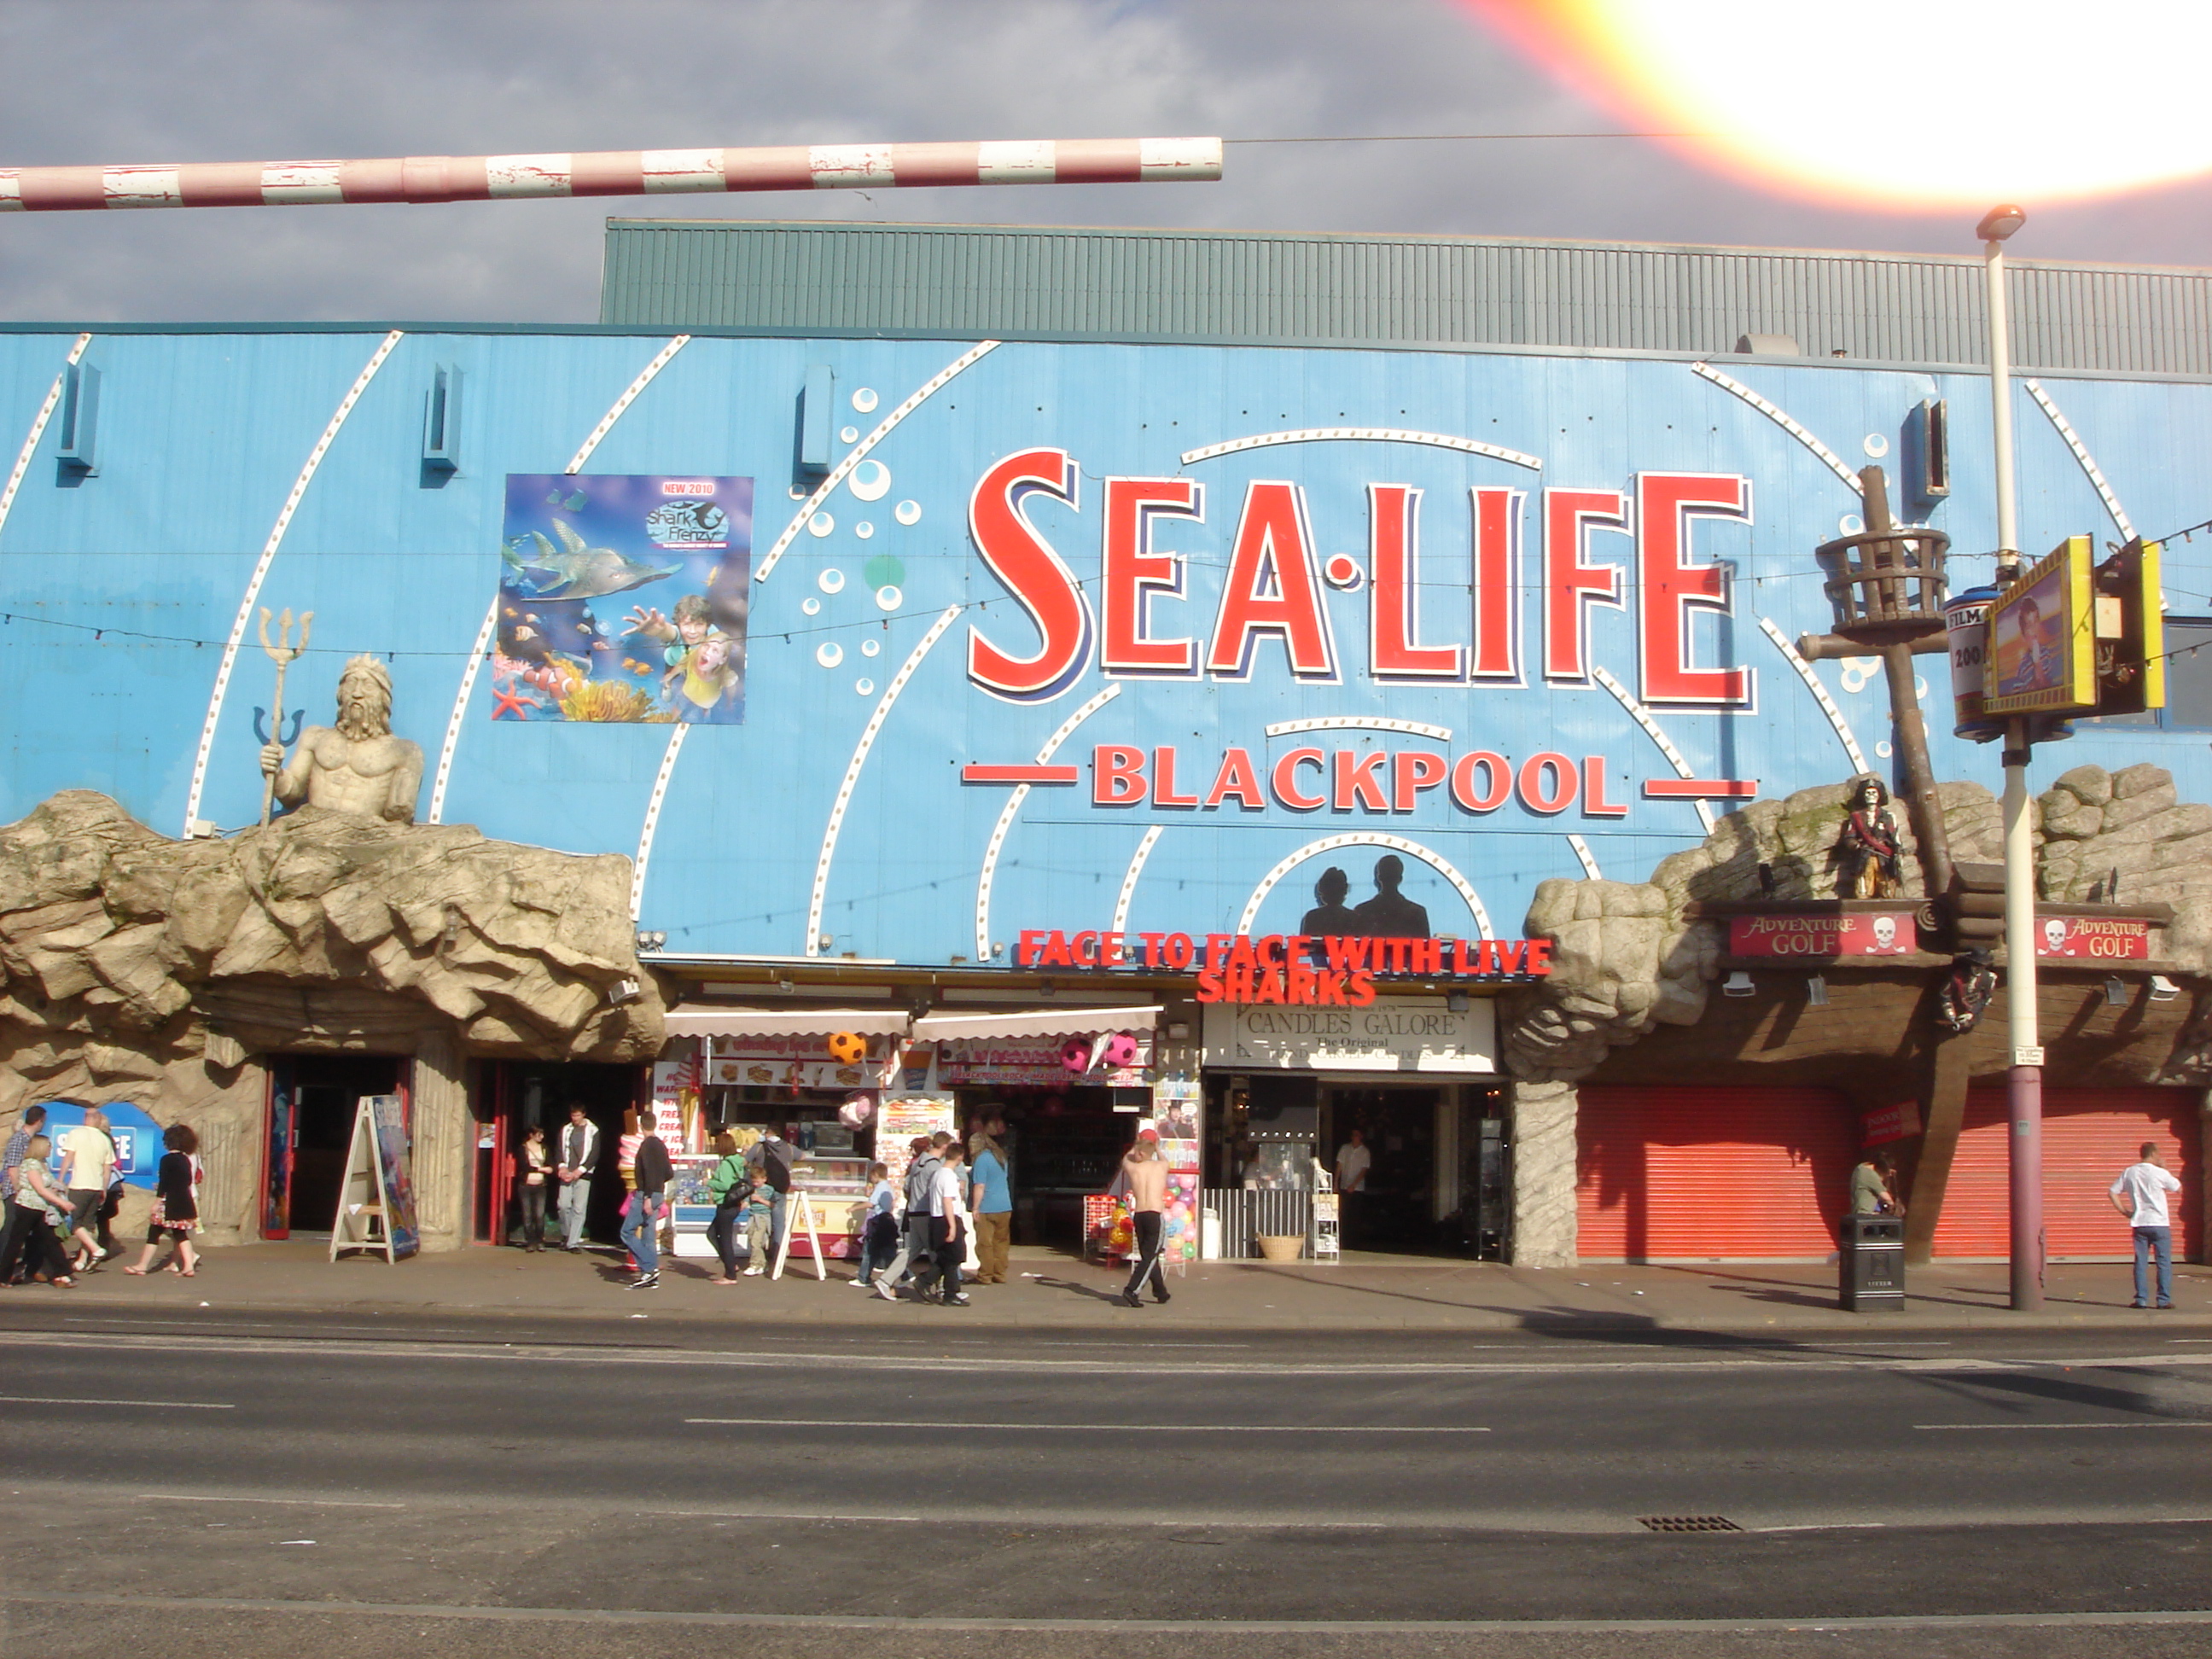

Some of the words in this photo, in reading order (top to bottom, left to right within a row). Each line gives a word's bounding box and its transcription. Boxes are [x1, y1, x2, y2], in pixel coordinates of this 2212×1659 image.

[664, 483, 685, 493] NEW
[689, 484, 713, 493] 2010
[646, 509, 691, 527] Shark
[669, 526, 715, 544] Frenzy
[1949, 608, 1981, 627] FILM
[1092, 743, 1628, 817] BLACKPOOL
[1741, 917, 1857, 939] ADVENTURE
[2066, 919, 2147, 940] ADVENTURE
[1019, 930, 1126, 966] FACE
[1138, 932, 1194, 969] TO
[1205, 934, 1313, 970] FACE
[1324, 935, 1441, 973] WITH
[1453, 939, 1552, 975] LIVE
[1772, 934, 1836, 954] GOLF
[2089, 937, 2133, 958] GOLF
[1196, 967, 1377, 1007] SHARKS
[1248, 1012, 1352, 1034] CANDLES
[1365, 1013, 1456, 1035] GALORE
[1315, 1037, 1337, 1047] The
[1341, 1037, 1388, 1048] Original
[1375, 1050, 1433, 1061] CANDLES
